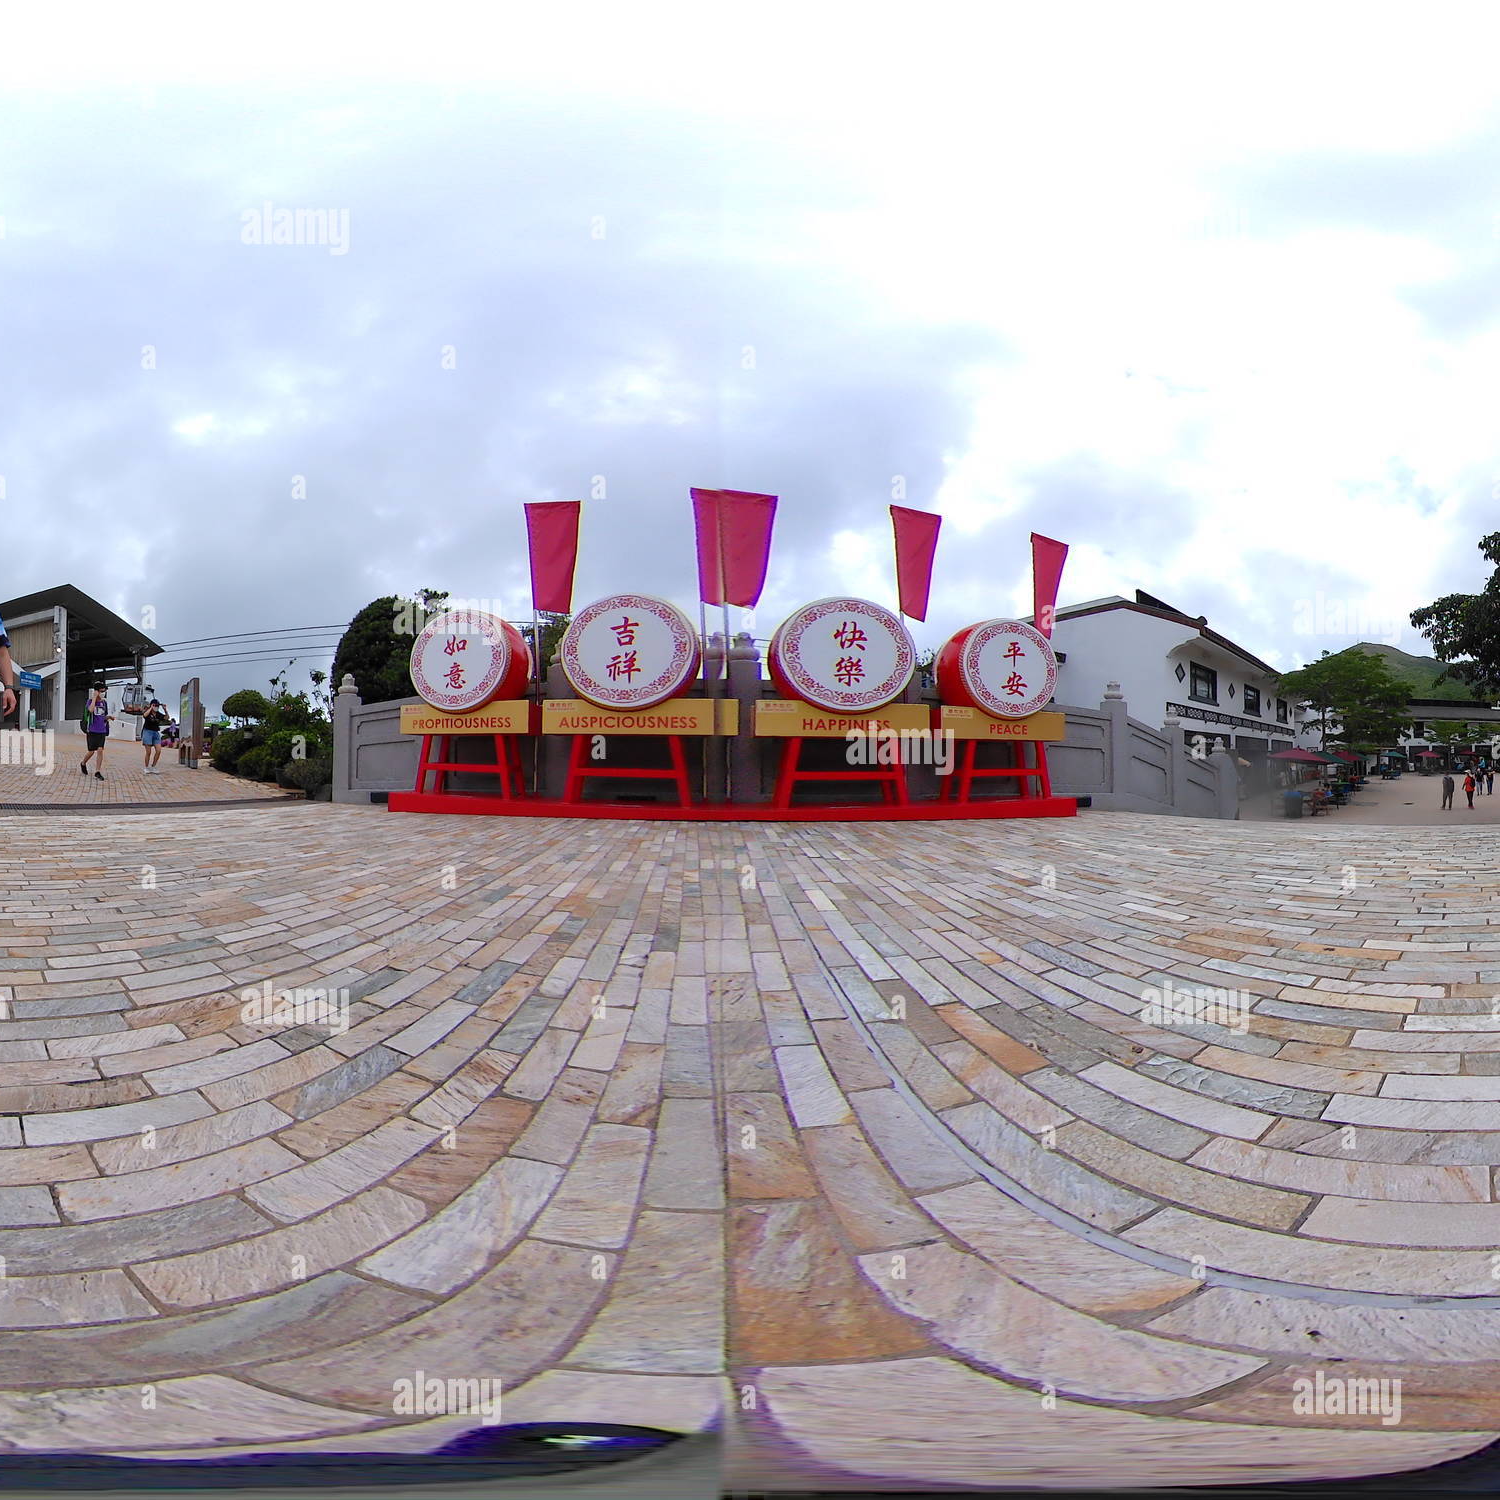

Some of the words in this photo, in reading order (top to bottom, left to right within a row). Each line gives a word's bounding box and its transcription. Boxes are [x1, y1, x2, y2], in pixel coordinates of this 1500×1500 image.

[443, 634, 468, 690] 如意
[606, 616, 642, 684] 吉祥
[833, 621, 868, 686] 快樂
[1001, 641, 1028, 697] 平安
[412, 717, 511, 729] PROPITIOUSNESS
[559, 716, 698, 729] AUSPICIOUSNESS
[802, 718, 891, 731] HAPPINESS
[989, 723, 1028, 735] PEACE
